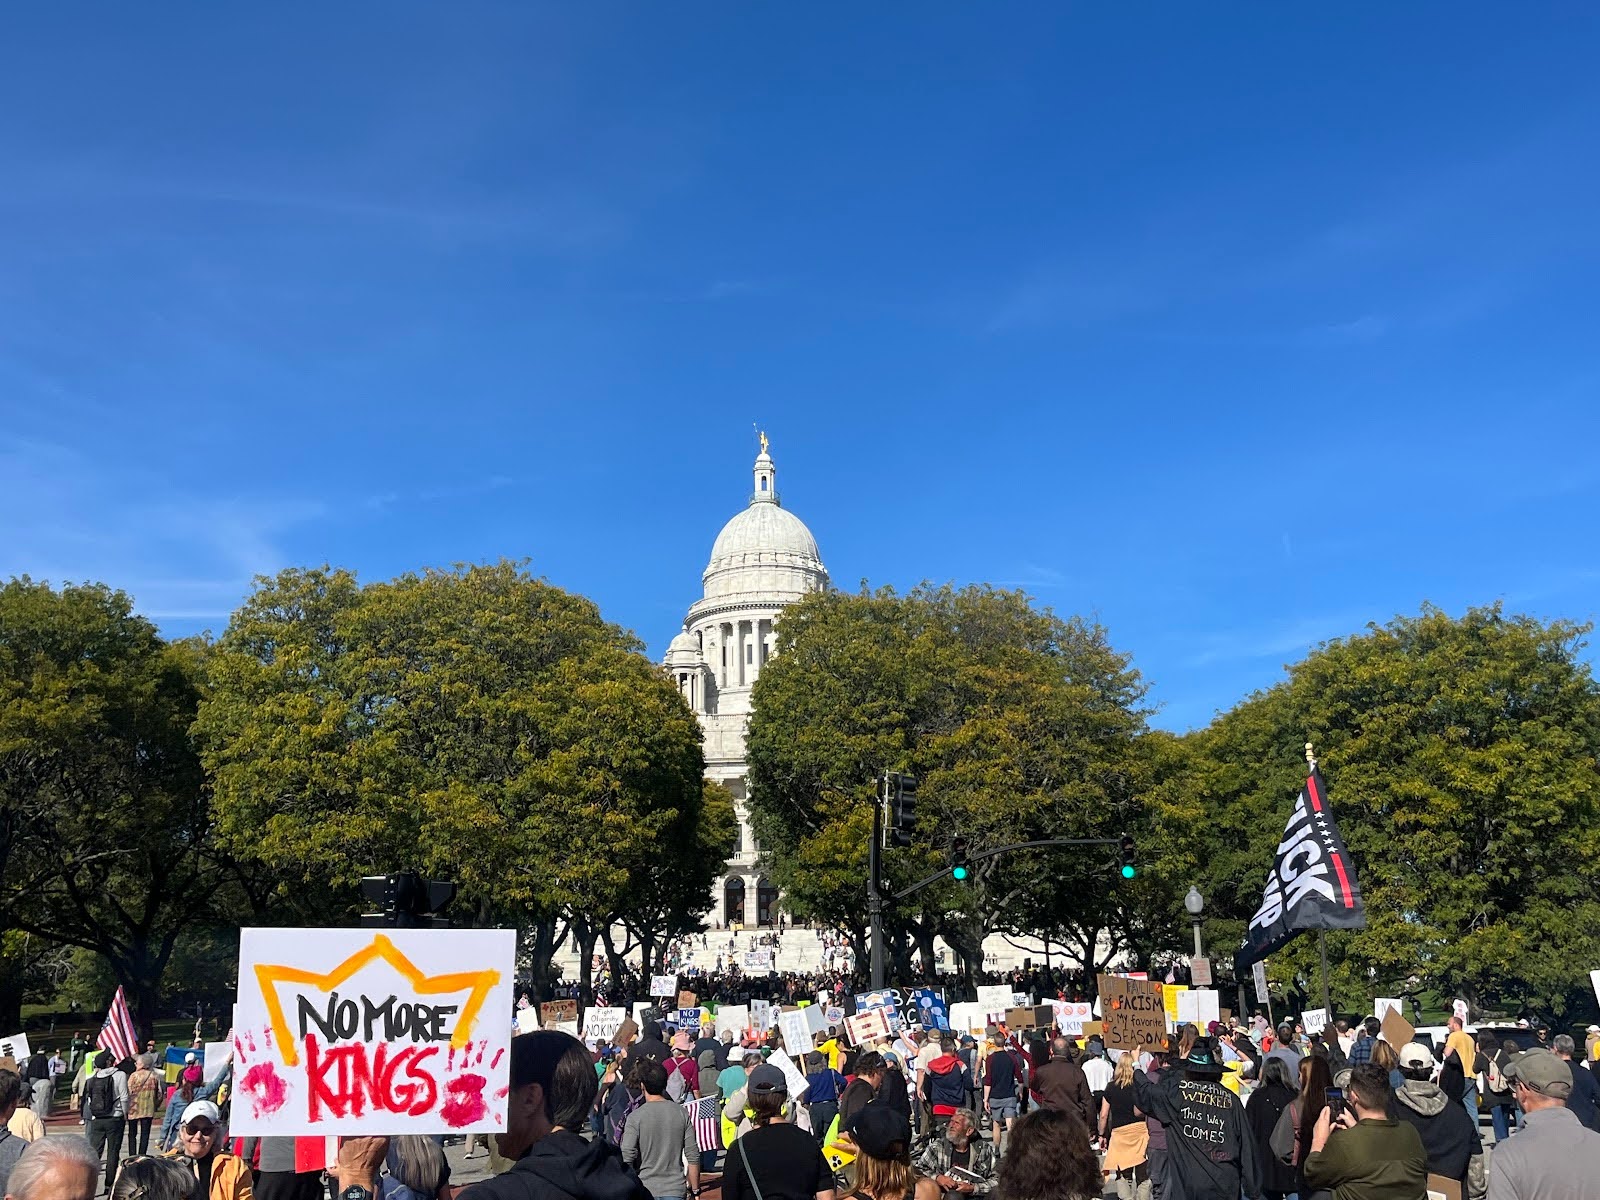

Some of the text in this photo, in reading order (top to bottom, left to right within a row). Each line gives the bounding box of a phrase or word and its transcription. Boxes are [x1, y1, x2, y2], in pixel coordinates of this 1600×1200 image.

[1276, 792, 1336, 911] UCK
[1127, 980, 1154, 995] FALL
[549, 1004, 568, 1012] AID
[1119, 995, 1164, 1012] FACISM
[297, 992, 458, 1043] NO MORE
[590, 1014, 619, 1023] Oligarchy
[597, 1008, 613, 1017] Fight
[1105, 1010, 1113, 1022] is
[1131, 1014, 1163, 1027] favorite
[586, 1023, 600, 1037] NO
[680, 1017, 699, 1026] KINGS
[1112, 1026, 1163, 1044] SEASON
[305, 1033, 440, 1123] KINGS
[1179, 1080, 1232, 1099] Something
[1182, 1090, 1232, 1108] WICKED
[1181, 1107, 1225, 1130] This Way
[1183, 1124, 1225, 1144] COMES
